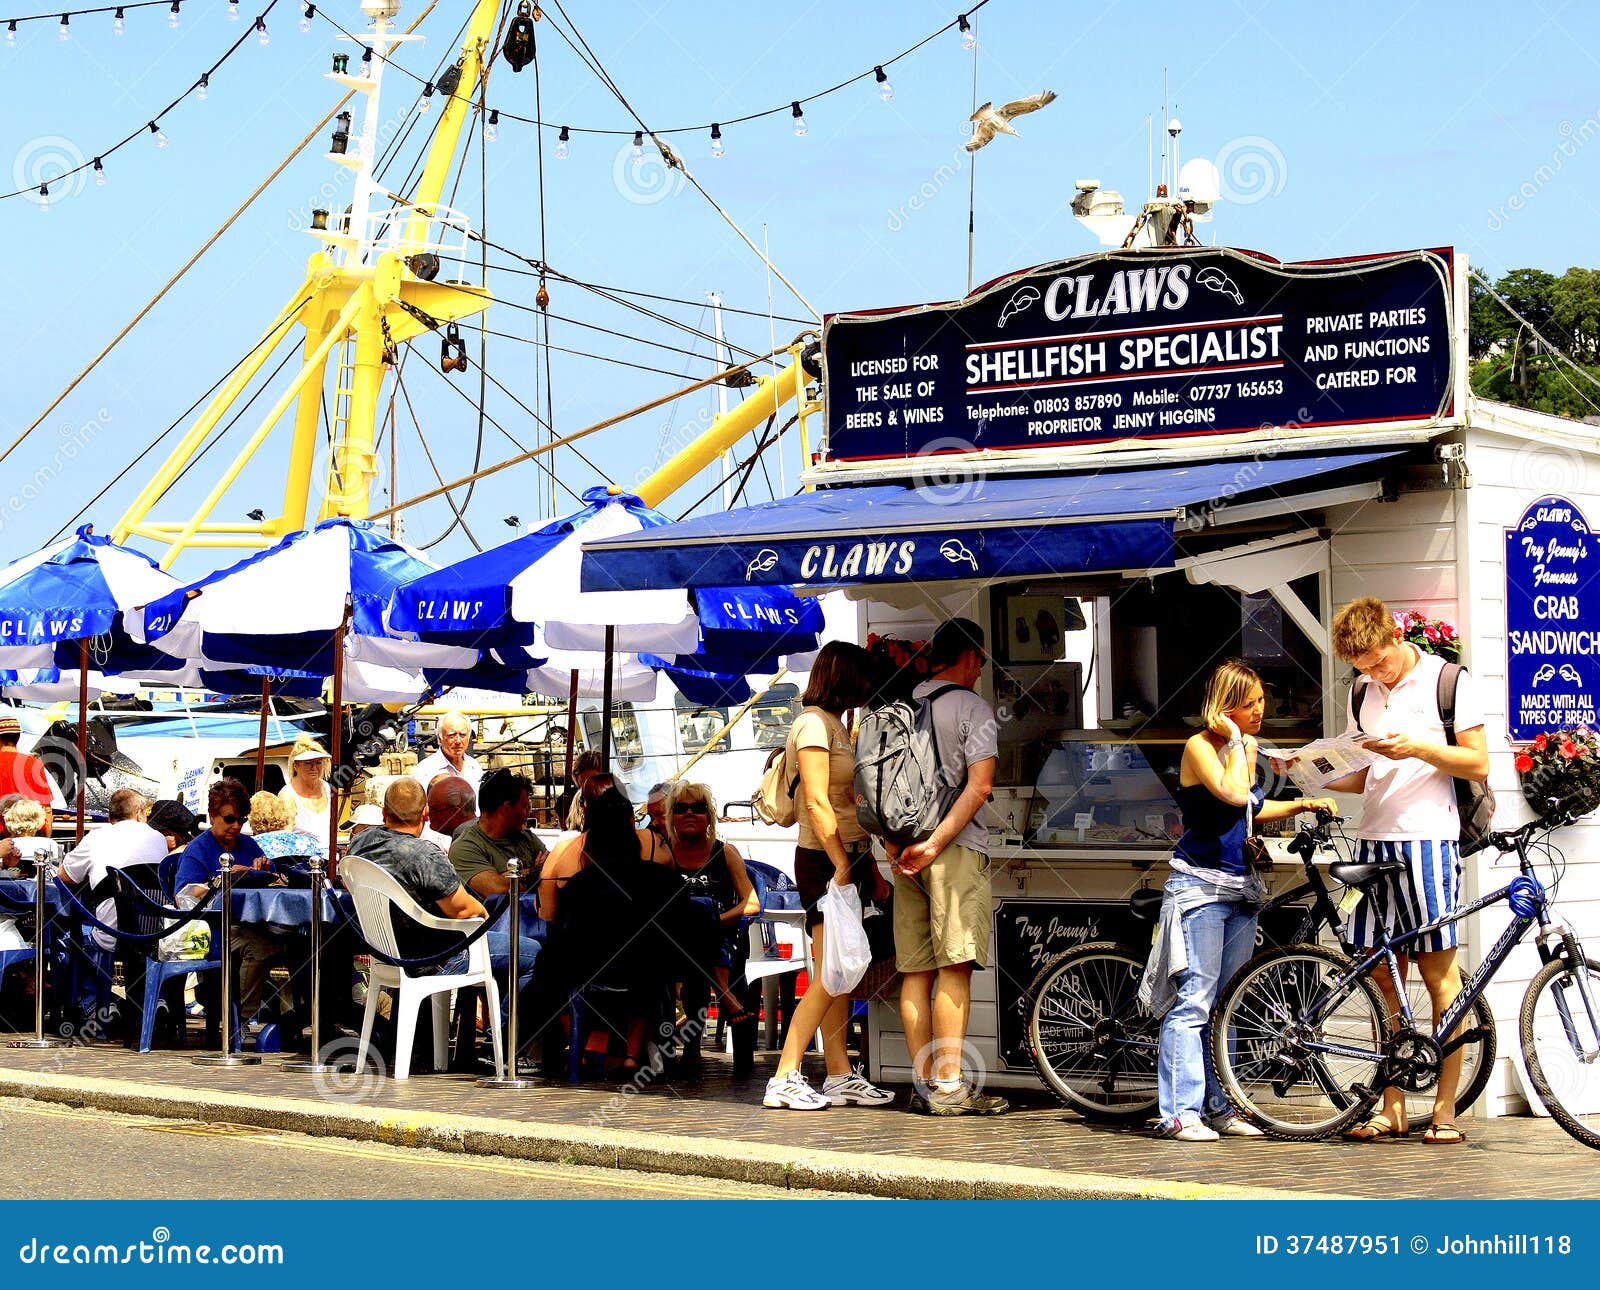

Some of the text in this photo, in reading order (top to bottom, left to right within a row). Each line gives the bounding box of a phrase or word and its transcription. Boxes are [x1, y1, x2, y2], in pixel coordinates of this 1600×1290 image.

[1044, 264, 1191, 322] CLAWS
[1306, 307, 1427, 334] PRIVATE PARTIES
[965, 325, 1284, 384] SHELLFISH SPECIALIST
[1304, 336, 1430, 363] AND FUNCTIONS
[851, 354, 939, 377] LICENSED FOR
[1316, 366, 1417, 390] CATERED FOR
[856, 381, 936, 403] THE SALE OF
[966, 379, 1284, 422] Telephone: 01803 857890 Mobile: 07737 165653
[846, 406, 944, 430] BEERS & WINES
[1028, 407, 1216, 436] PROPRIETOR JENNY HIGGINS
[1536, 507, 1572, 523] CLAWS
[800, 540, 916, 579] CLAWS
[1521, 536, 1588, 564] Try Jenny's
[1532, 564, 1578, 587] Famous
[418, 600, 483, 621] CLAWS
[722, 602, 799, 625] CLAWS
[1533, 595, 1579, 620] CRAB
[1, 618, 84, 637] CLAWS
[1511, 630, 1600, 655] SANDWICH
[1521, 694, 1594, 709] MADE WITH ALL
[1519, 709, 1596, 725] TYPES OF BREAD
[1015, 916, 1100, 945] Try Jenny's
[1049, 974, 1080, 993] RAB
[1017, 996, 1103, 1018] SNDWICH
[1063, 1026, 1084, 1038] WITH
